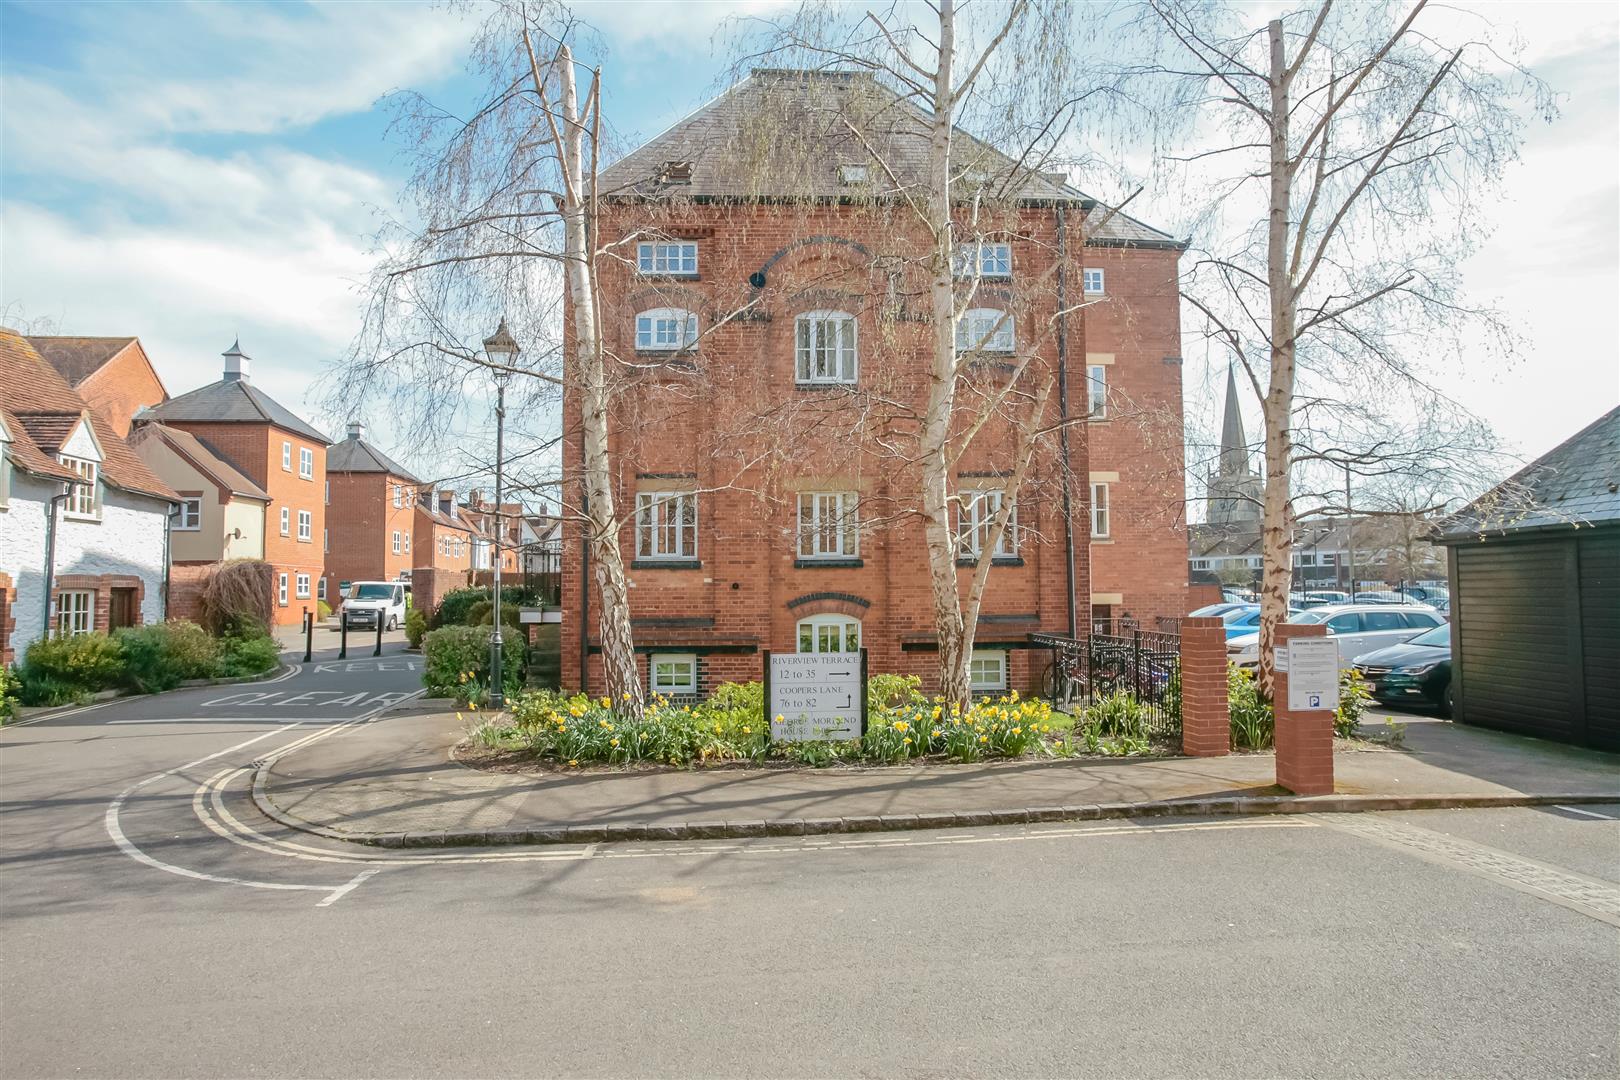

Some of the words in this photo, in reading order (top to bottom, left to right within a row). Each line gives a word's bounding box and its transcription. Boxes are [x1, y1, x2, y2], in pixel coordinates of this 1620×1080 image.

[772, 656, 818, 665] RIVERVIEW
[821, 655, 857, 664] TERRACE
[779, 669, 790, 680] 12
[806, 669, 816, 679] 35
[200, 691, 412, 708] CLEAR
[779, 698, 790, 707] 76
[794, 698, 802, 706] to
[806, 698, 816, 707] 82
